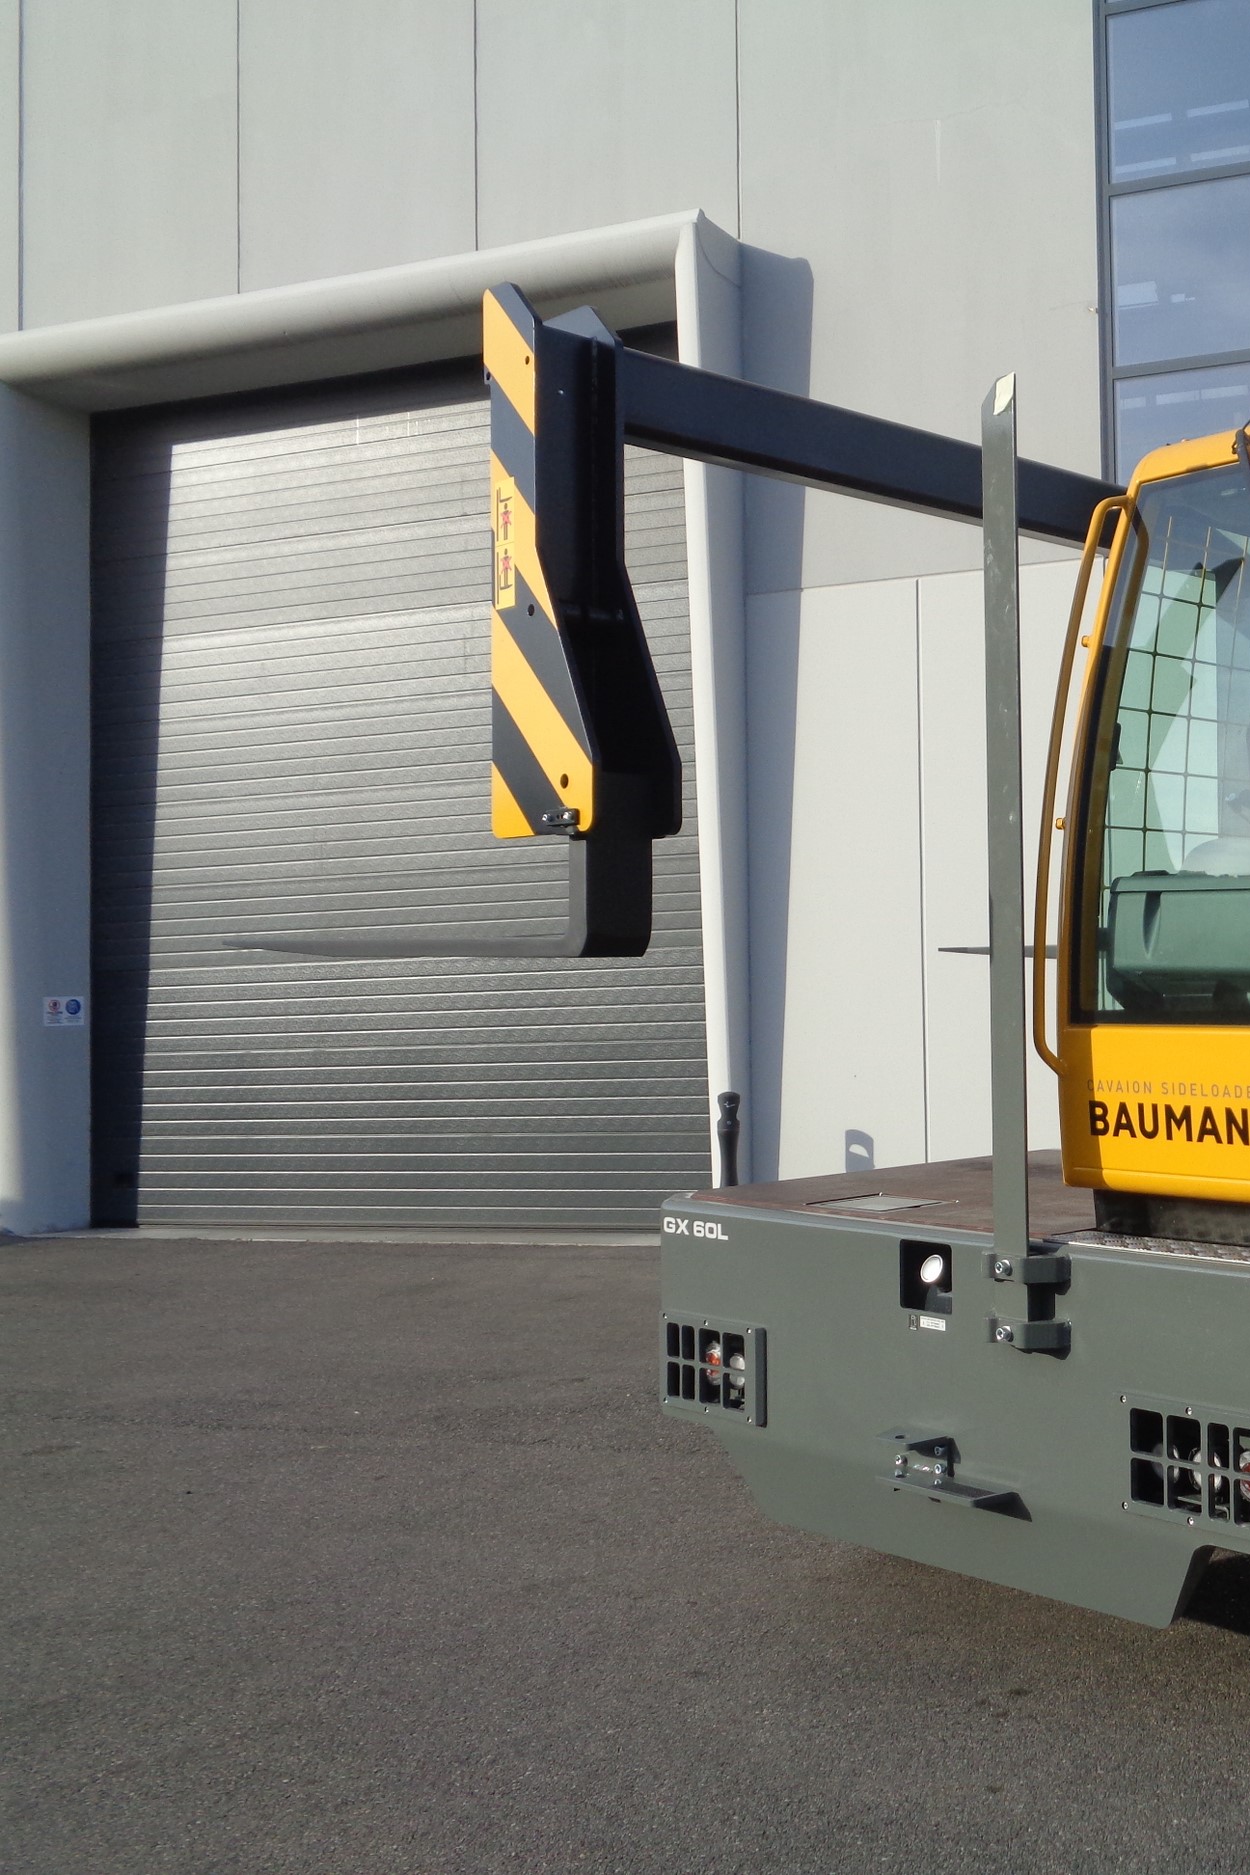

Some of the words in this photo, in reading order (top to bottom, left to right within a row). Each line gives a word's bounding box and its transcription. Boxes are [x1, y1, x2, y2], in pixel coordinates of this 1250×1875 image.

[1087, 1079, 1152, 1094] CAVAION
[663, 1216, 690, 1236] GX
[693, 1220, 729, 1241] 60L
